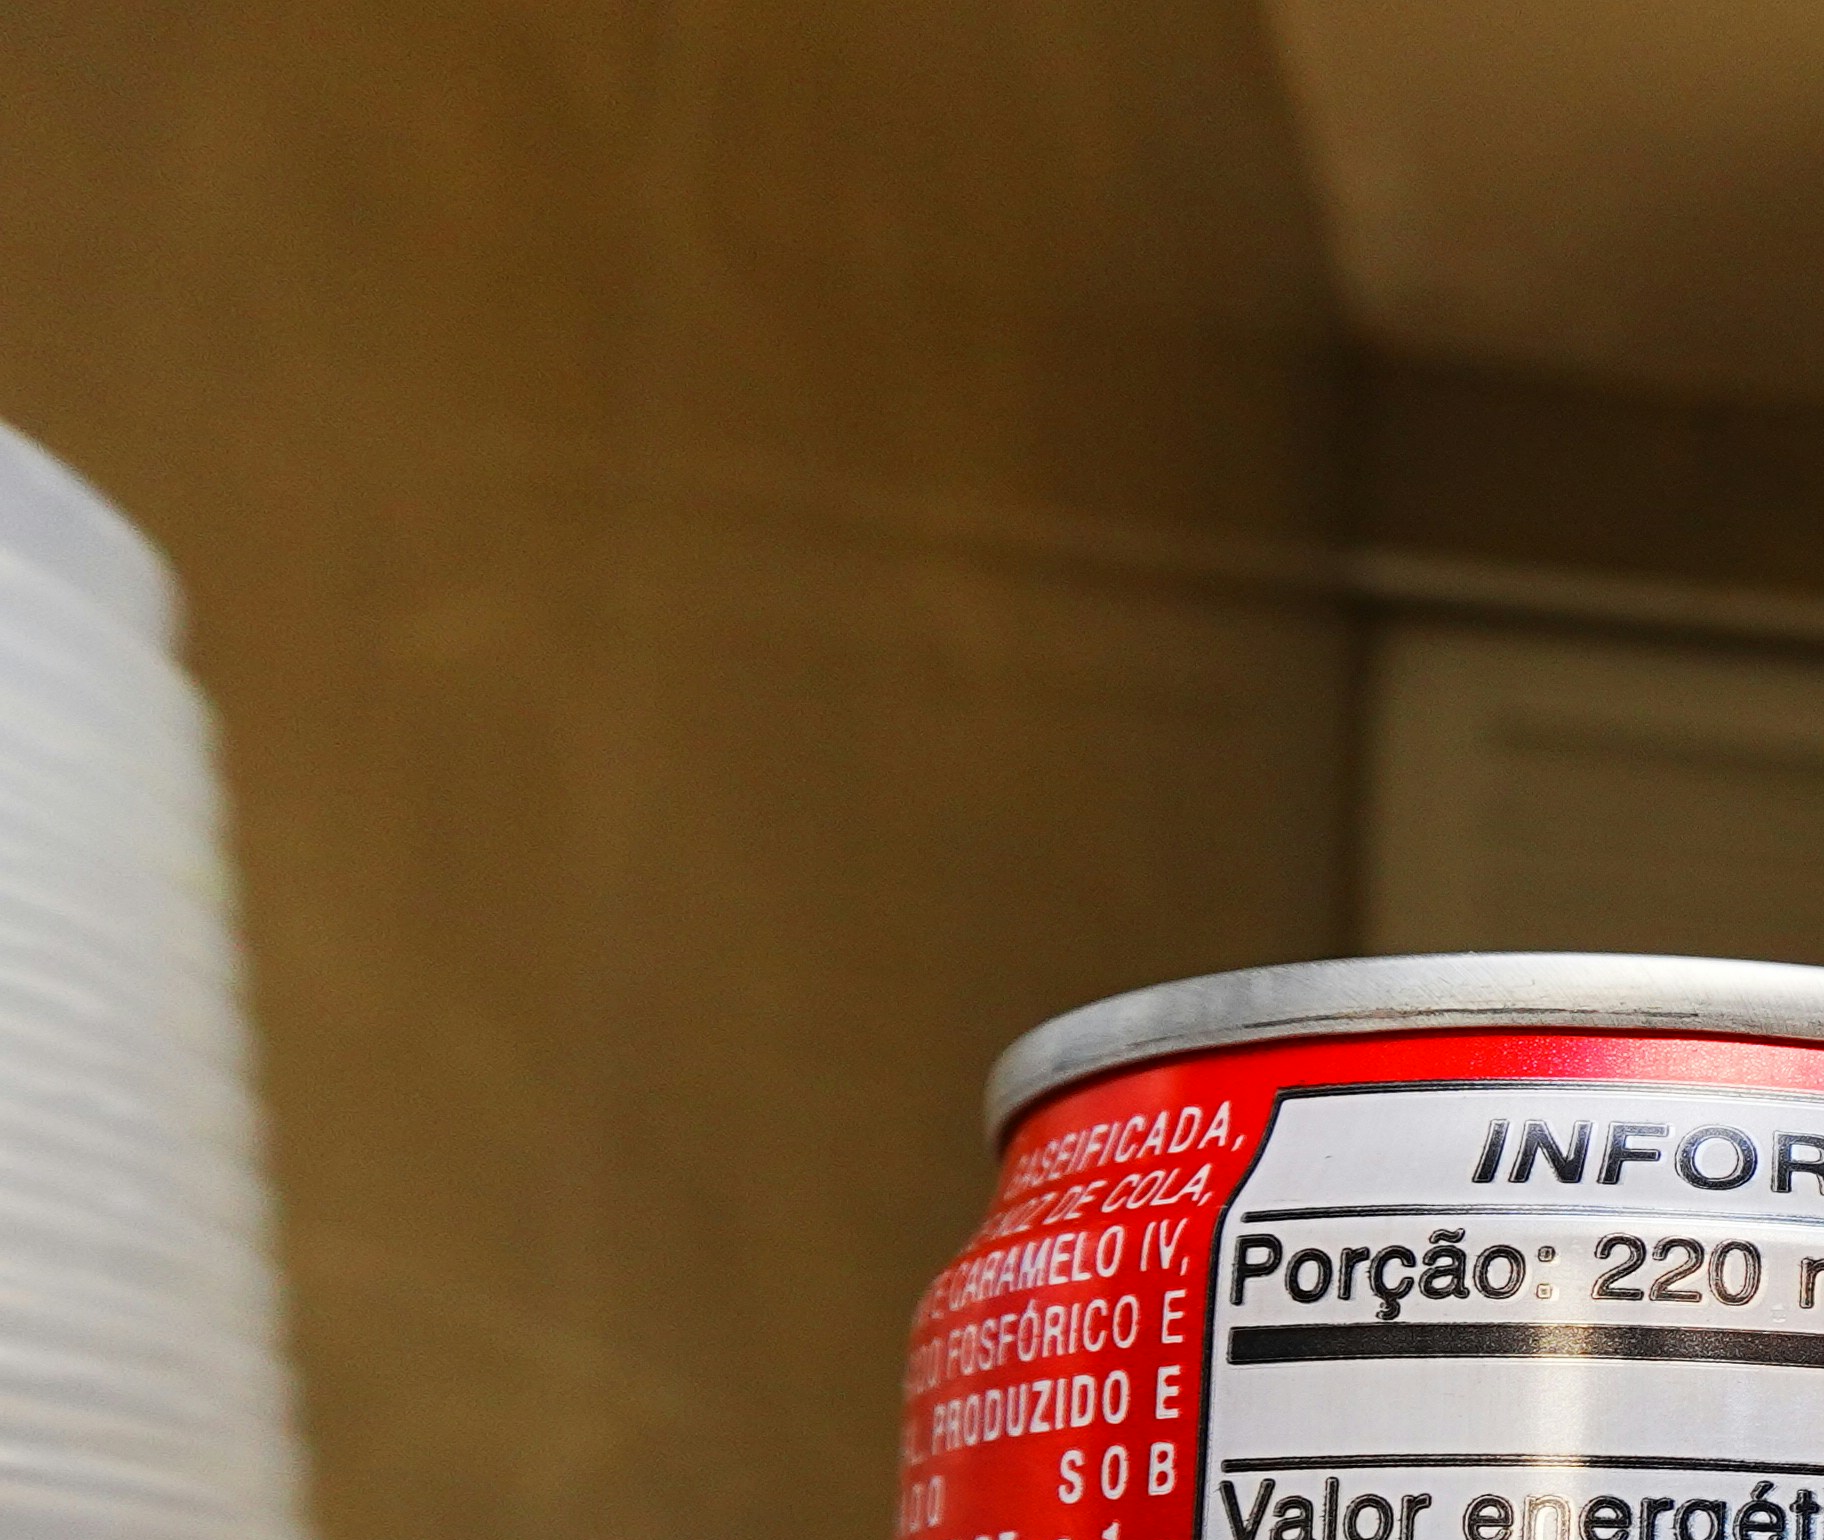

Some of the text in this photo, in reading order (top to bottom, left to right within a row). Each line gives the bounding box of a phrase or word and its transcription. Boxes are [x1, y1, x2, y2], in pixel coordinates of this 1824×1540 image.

[1042, 1179, 1108, 1226] DE
[1100, 1162, 1214, 1215] COLA,
[948, 1223, 1126, 1313] CARAMELO
[1139, 1216, 1189, 1277] IV,
[1228, 1227, 1557, 1321] Porção:
[1591, 1232, 1763, 1307] 220
[946, 1294, 1140, 1379] FOSFÓRICO
[1160, 1289, 1187, 1345] E
[930, 1369, 1131, 1457] PRODUZIDO
[1154, 1364, 1182, 1420] E
